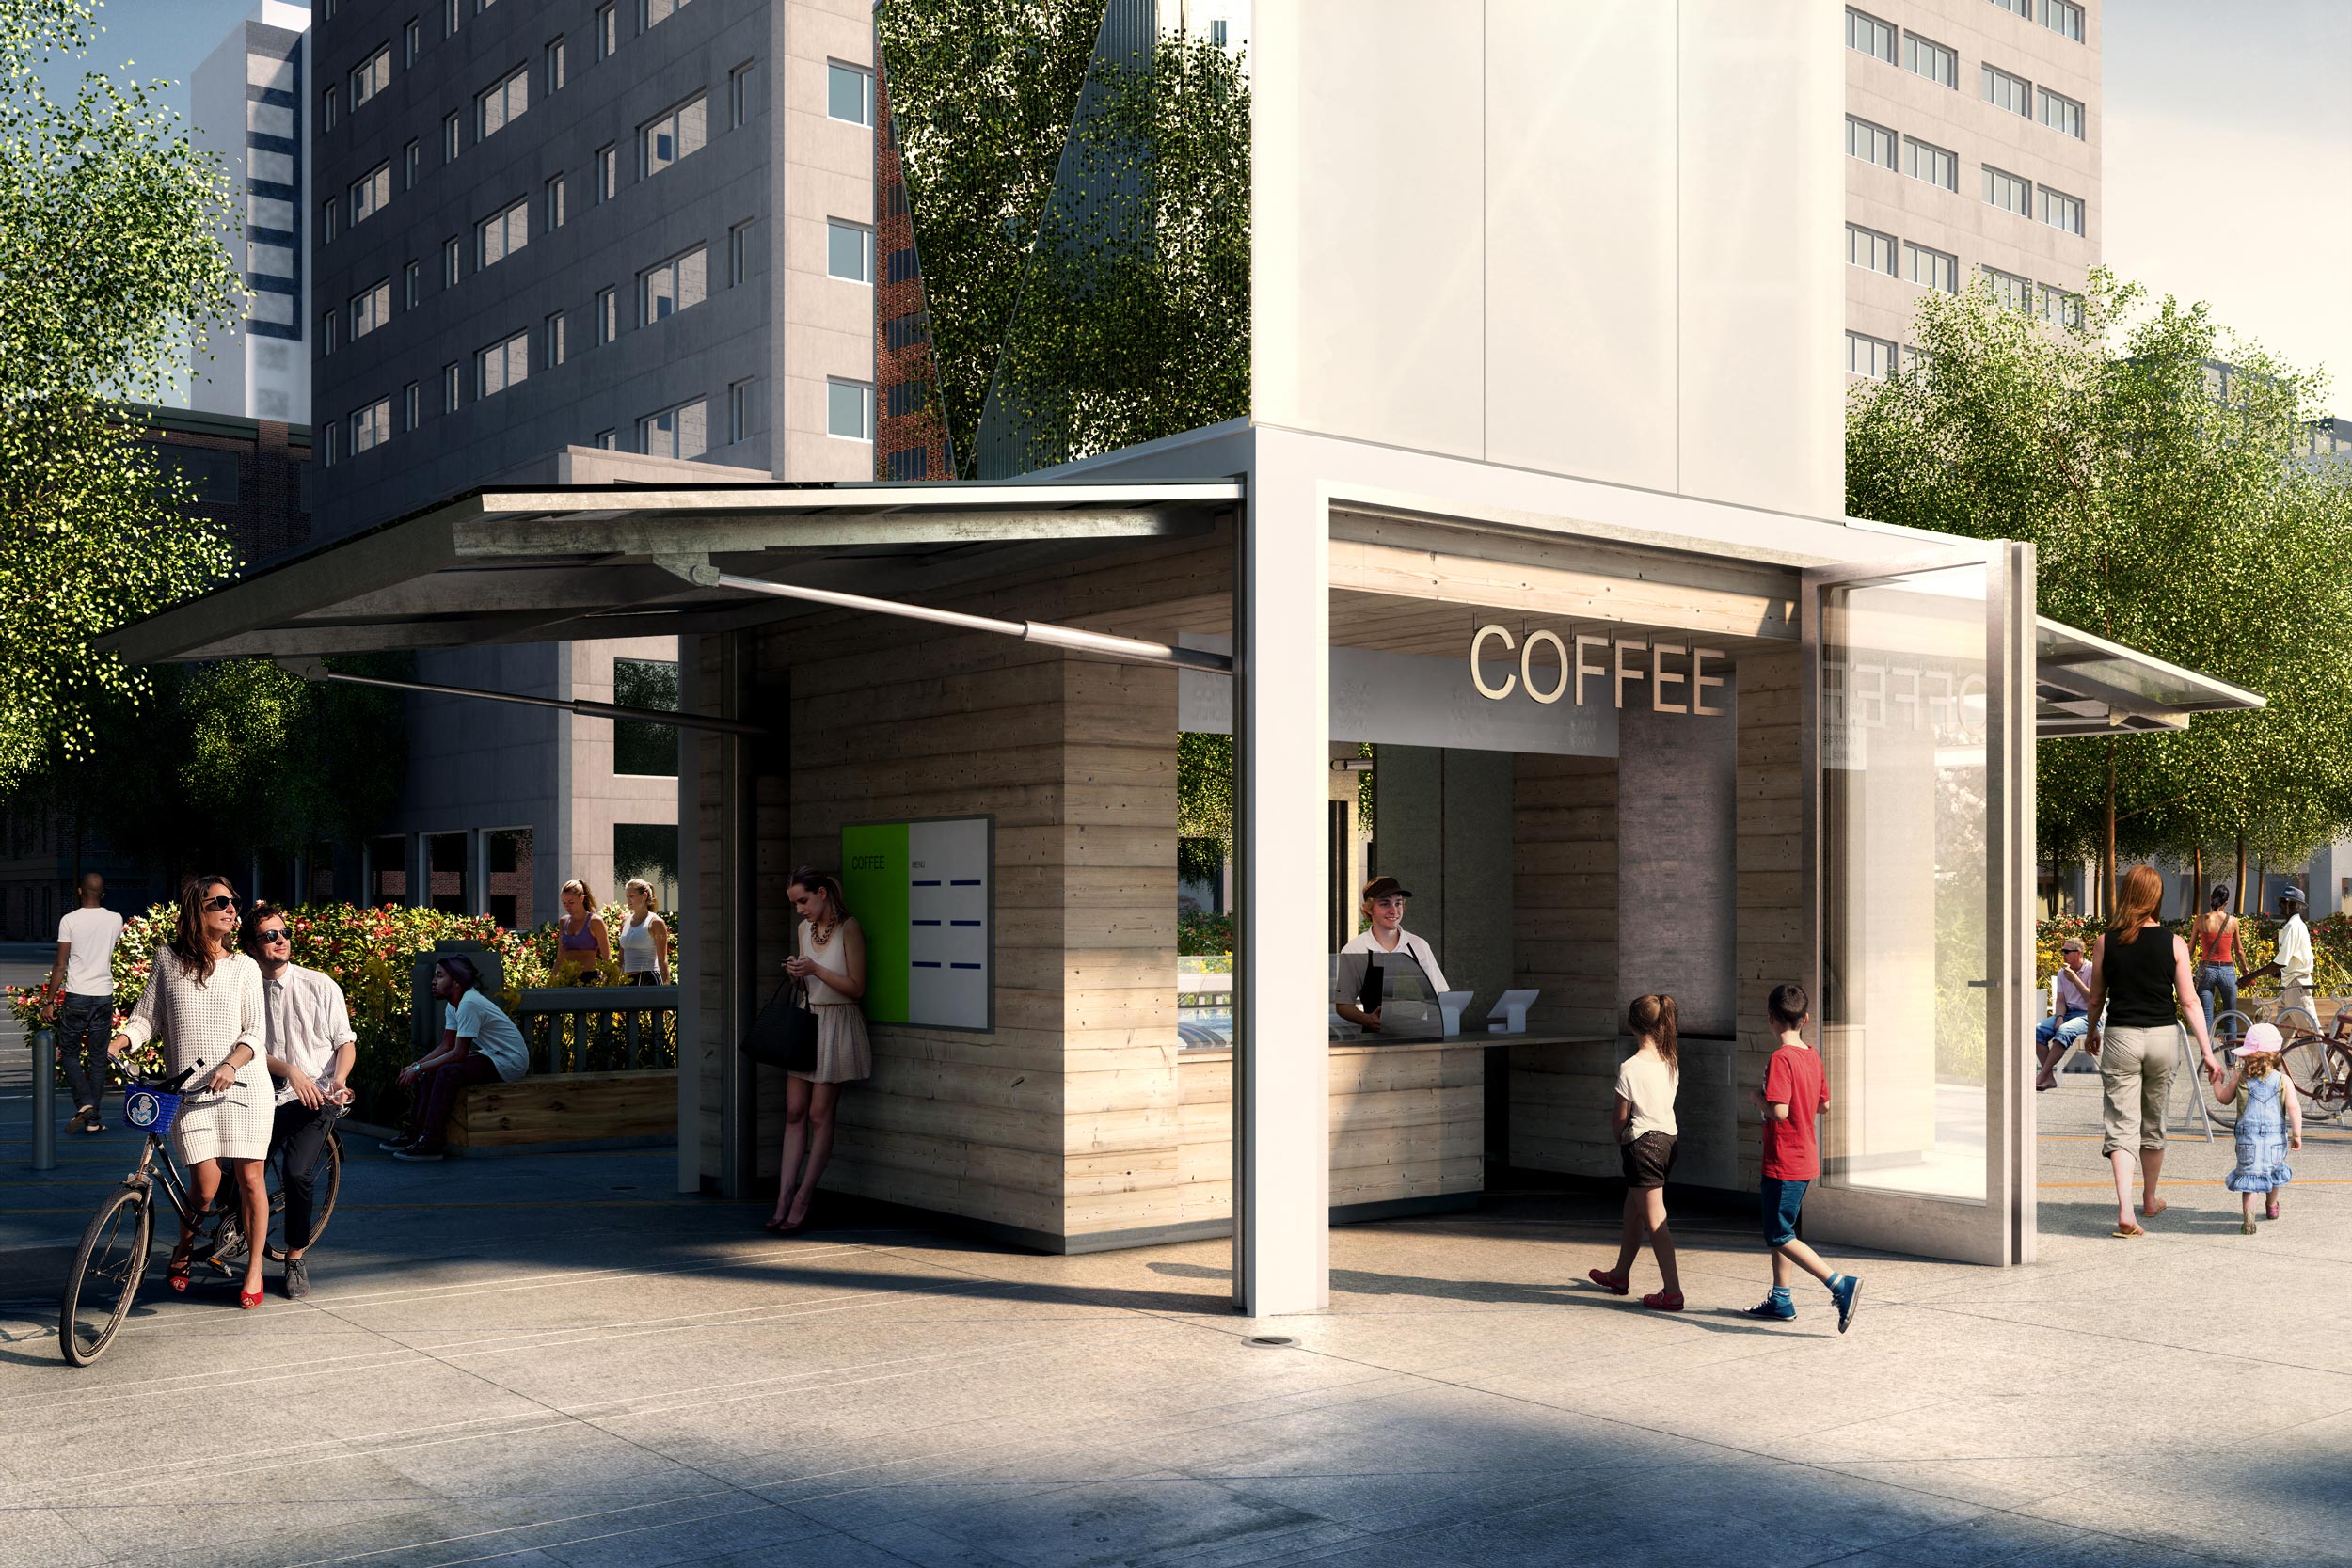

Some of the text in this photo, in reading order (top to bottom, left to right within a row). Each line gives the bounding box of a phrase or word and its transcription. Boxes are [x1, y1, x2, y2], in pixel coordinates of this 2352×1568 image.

[1470, 624, 1725, 717] COFFEE
[851, 855, 886, 870] COFFEE
[912, 861, 926, 869] MENU
